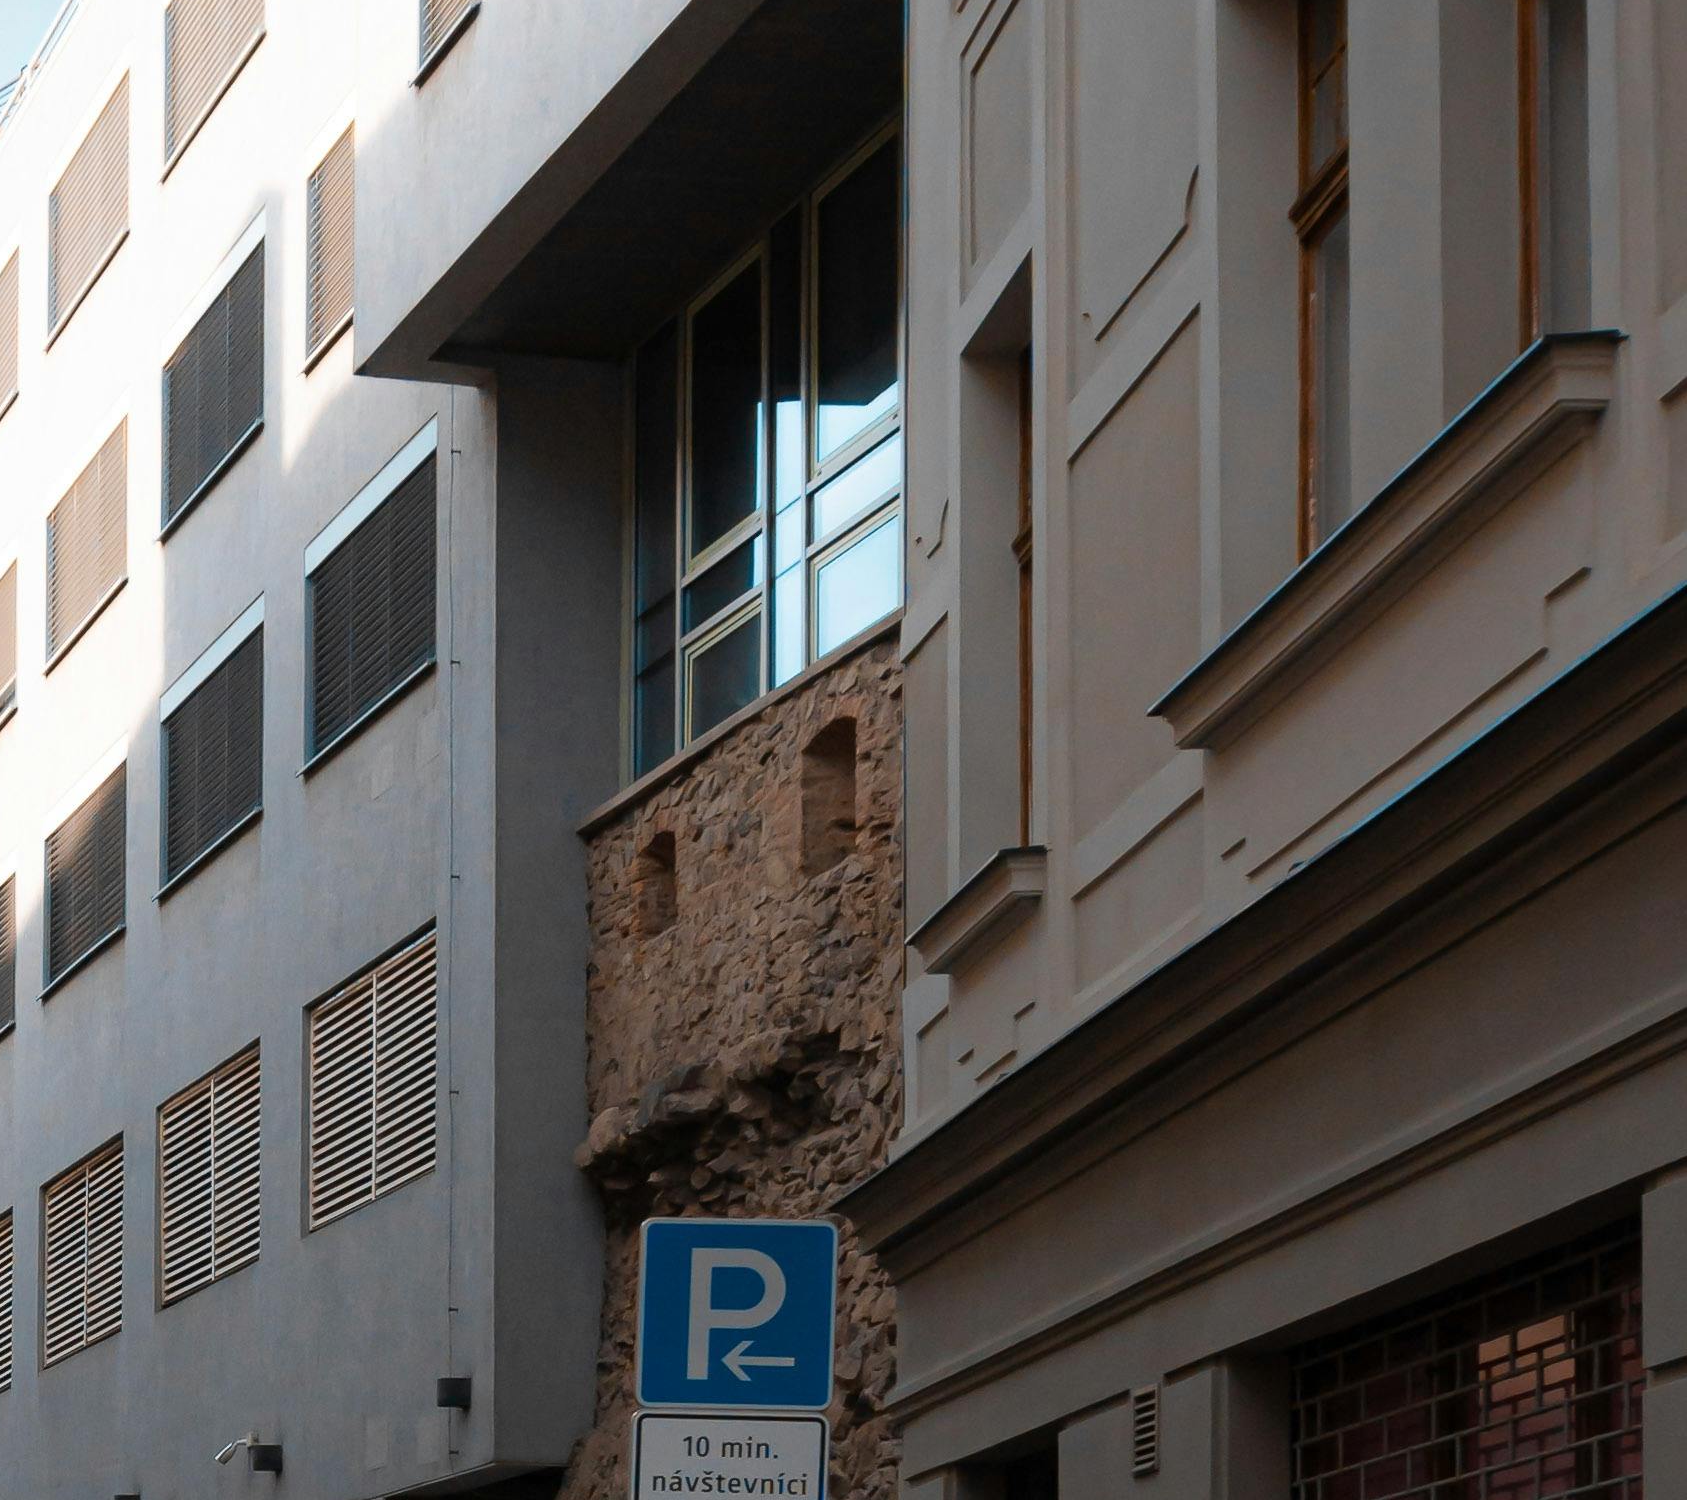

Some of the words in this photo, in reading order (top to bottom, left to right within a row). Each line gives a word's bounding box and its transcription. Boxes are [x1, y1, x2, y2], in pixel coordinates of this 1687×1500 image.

[686, 1247, 787, 1381] P
[683, 1435, 710, 1457] 10
[721, 1436, 779, 1459] min.
[652, 1469, 808, 1495] návštevníci
